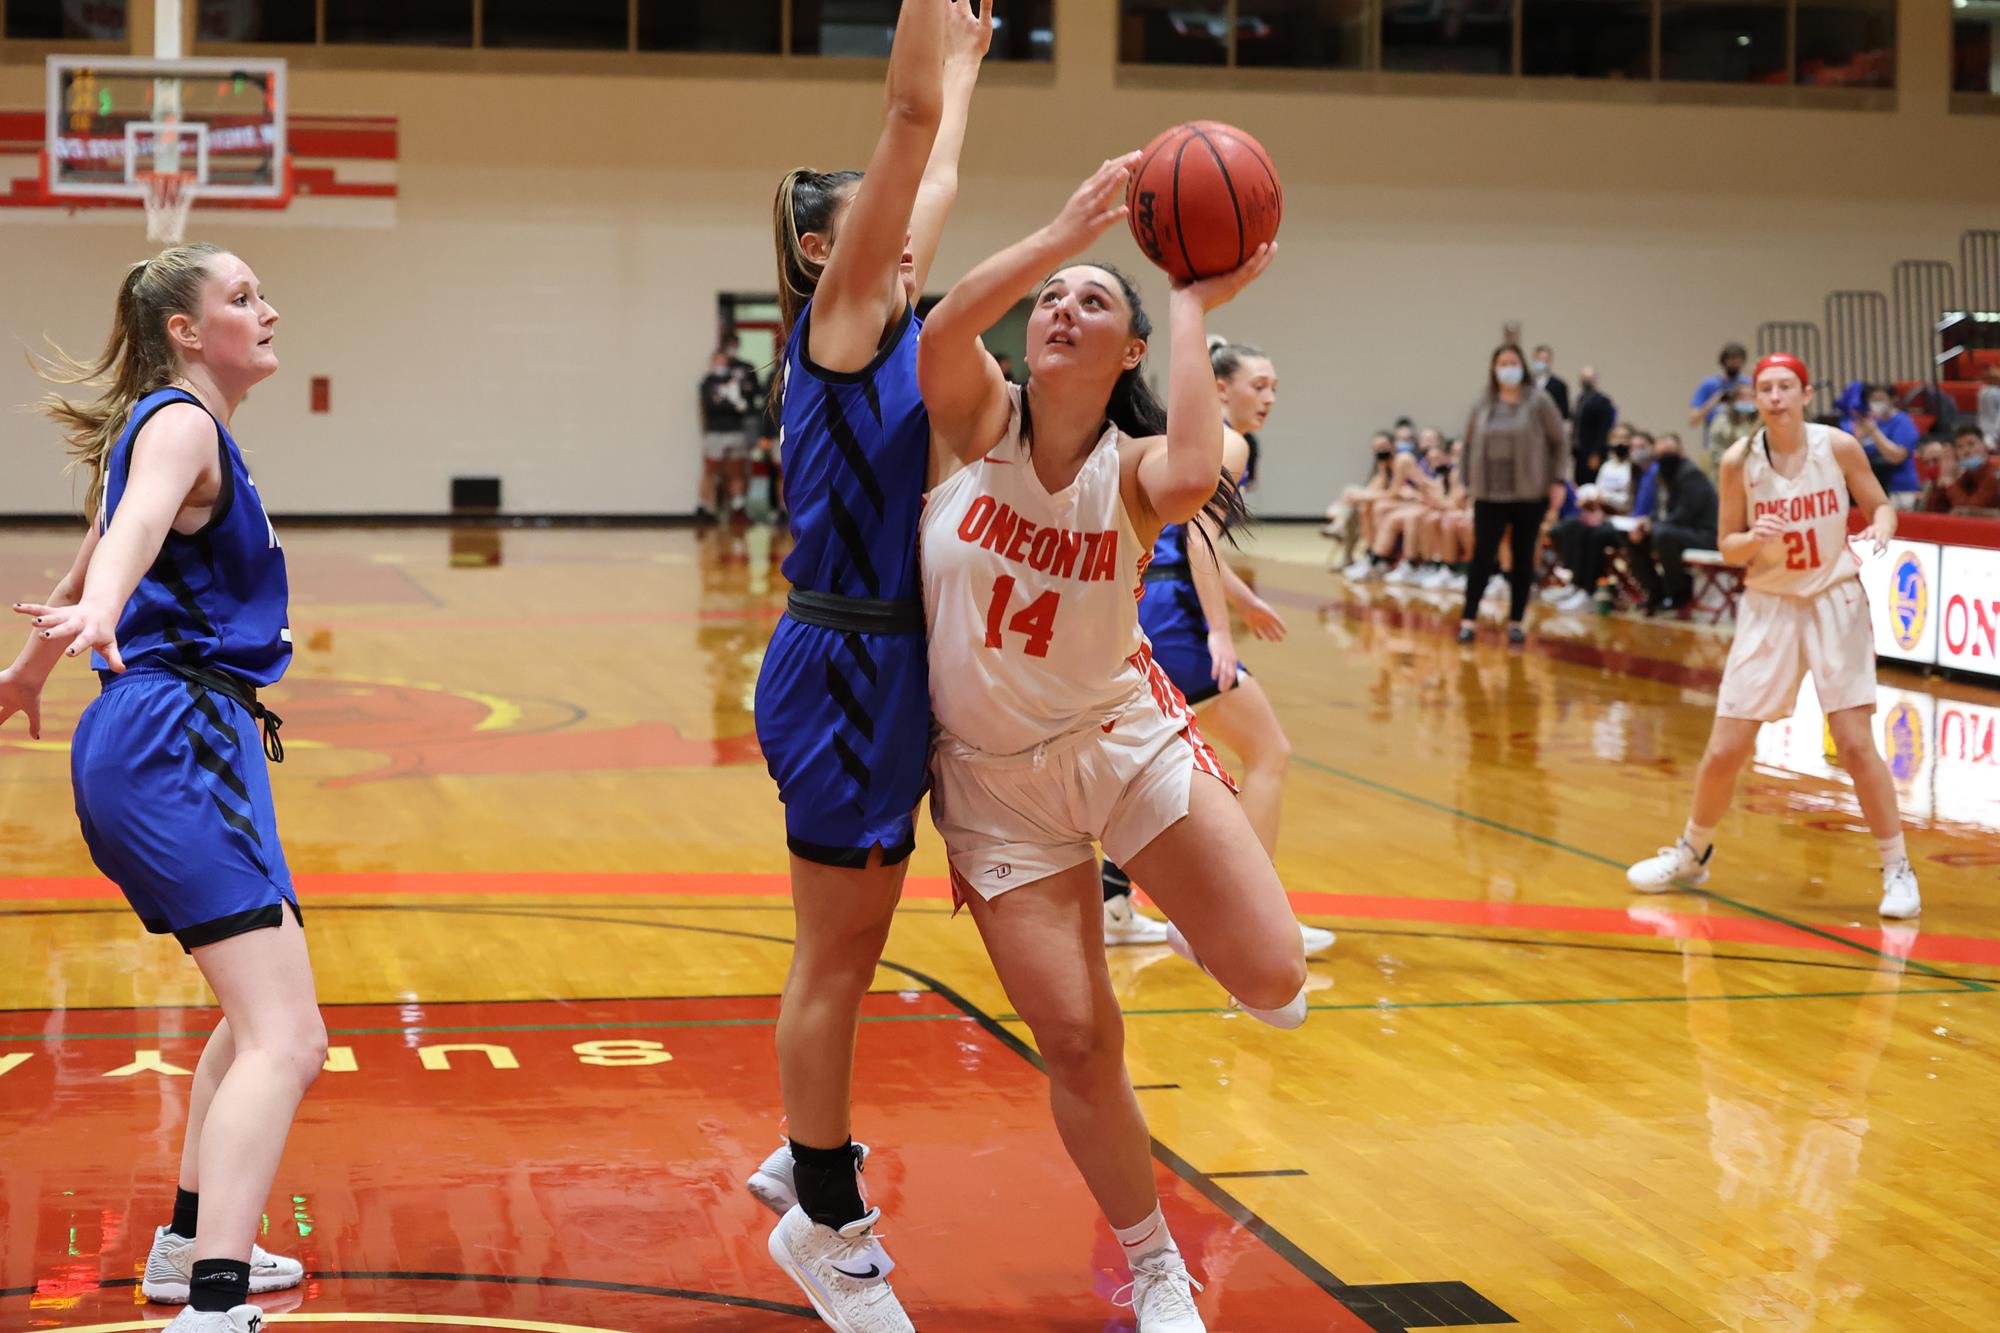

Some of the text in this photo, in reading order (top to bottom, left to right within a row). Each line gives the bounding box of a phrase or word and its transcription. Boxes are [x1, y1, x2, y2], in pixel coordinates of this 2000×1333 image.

[957, 494, 1118, 582] ONEONTA
[1755, 488, 1839, 522] ONEONTA
[1783, 528, 1822, 570] 21
[984, 574, 1061, 658] 14
[1945, 593, 2000, 660] ON
